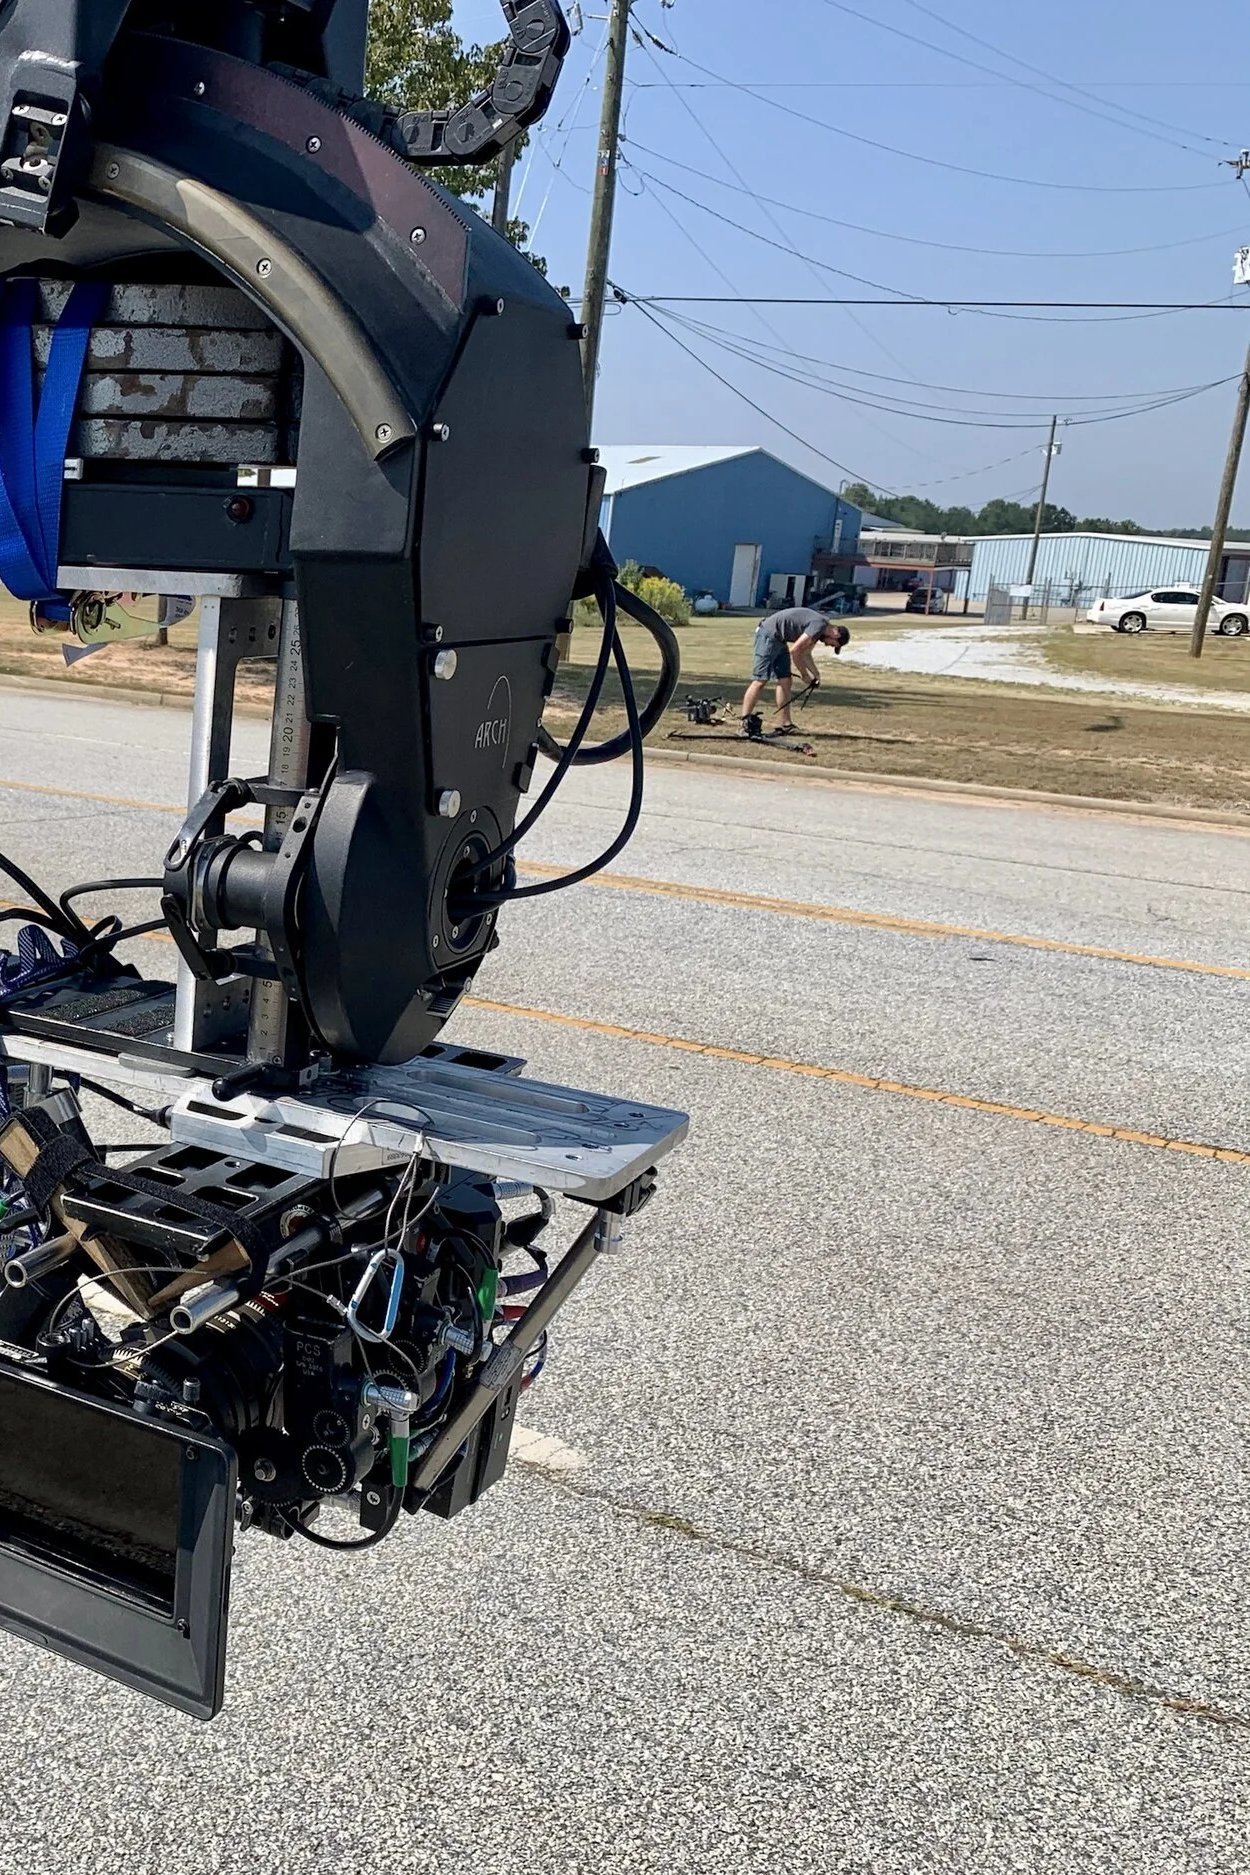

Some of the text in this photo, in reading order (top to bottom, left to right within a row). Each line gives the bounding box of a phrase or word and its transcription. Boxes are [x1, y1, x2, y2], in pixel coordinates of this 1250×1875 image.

[290, 639, 301, 656] 25
[290, 660, 298, 672] 24
[288, 677, 297, 689] 23
[287, 693, 296, 706] 22
[285, 712, 294, 724] 21
[283, 726, 294, 743] 20
[474, 719, 508, 749] ARCH
[283, 746, 291, 758] 19
[281, 763, 290, 774] 18
[275, 811, 287, 825] 15
[262, 980, 273, 989] 5
[296, 1340, 321, 1356] PCS
